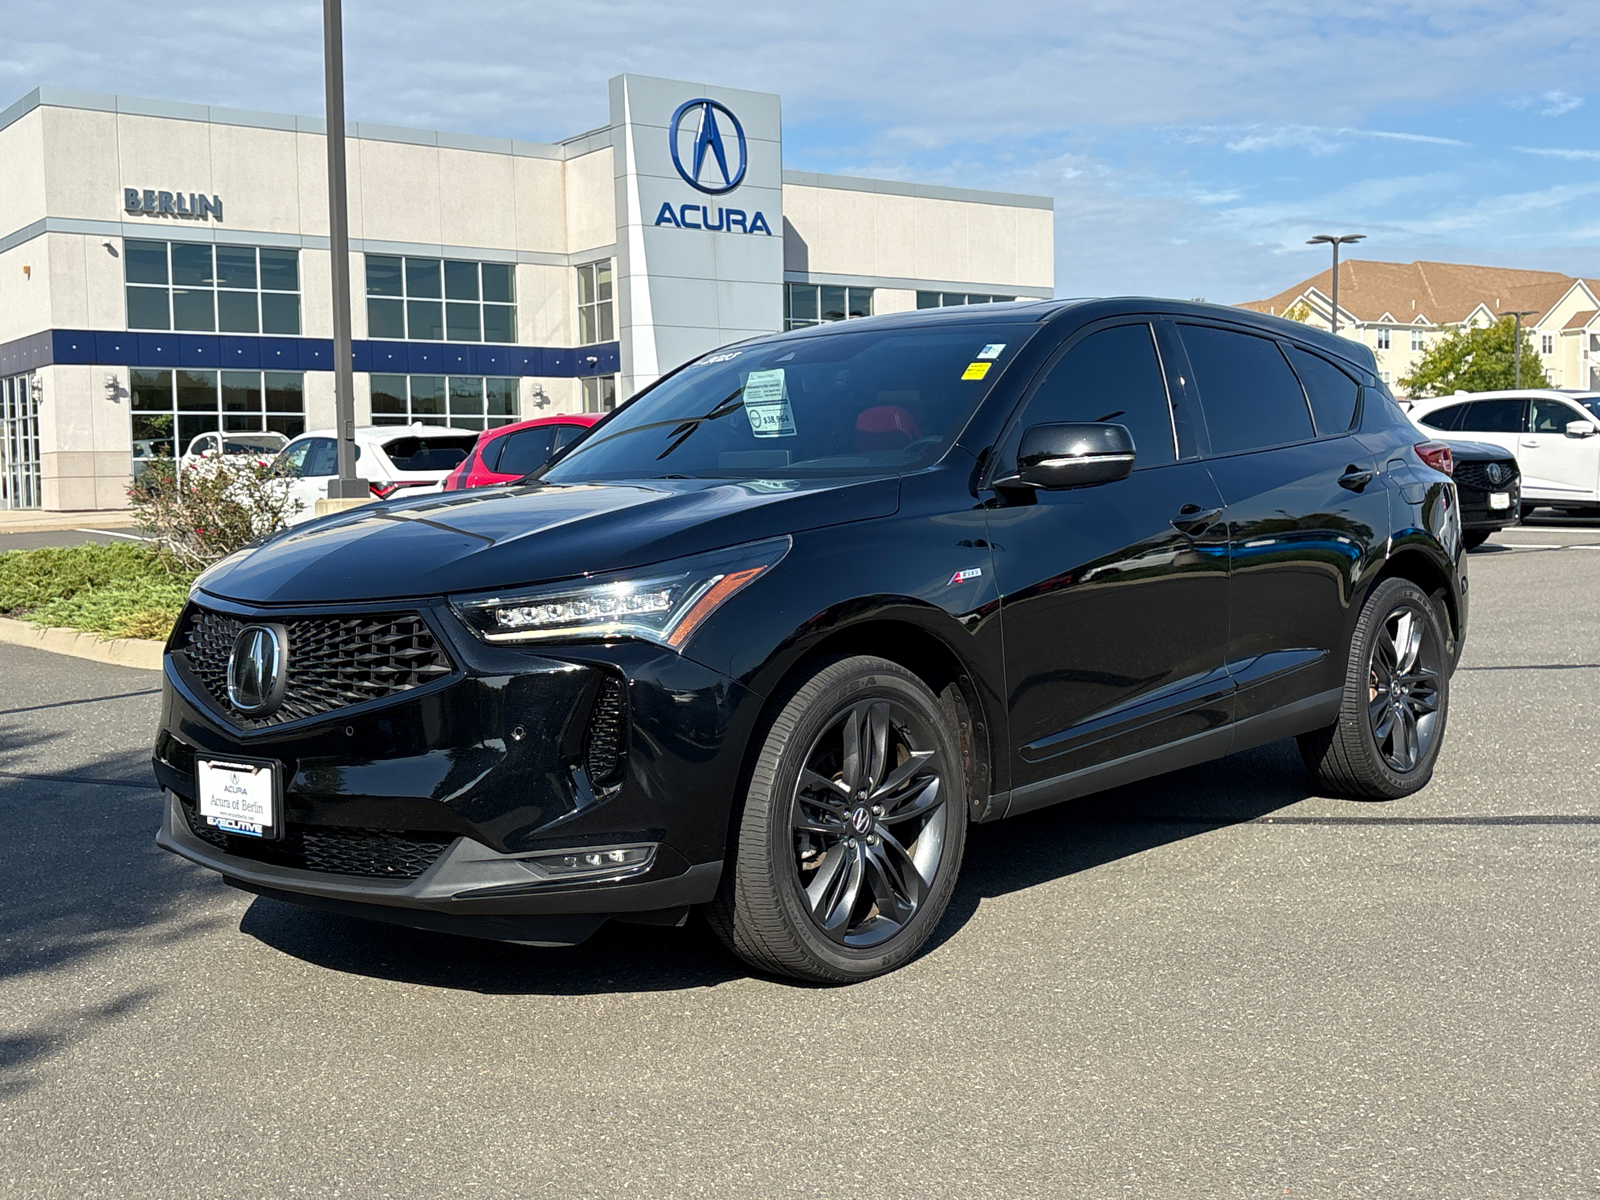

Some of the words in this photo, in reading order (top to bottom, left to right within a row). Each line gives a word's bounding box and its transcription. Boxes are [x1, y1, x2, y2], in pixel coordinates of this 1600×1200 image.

[124, 188, 222, 220] BERLIN
[655, 202, 772, 236] ACURA
[763, 415, 789, 425] $38,964
[224, 785, 248, 795] ACURA
[210, 794, 230, 809] Acura
[232, 799, 240, 810] of
[242, 799, 263, 815] Berlin
[207, 817, 262, 834] EXECUTIVE
